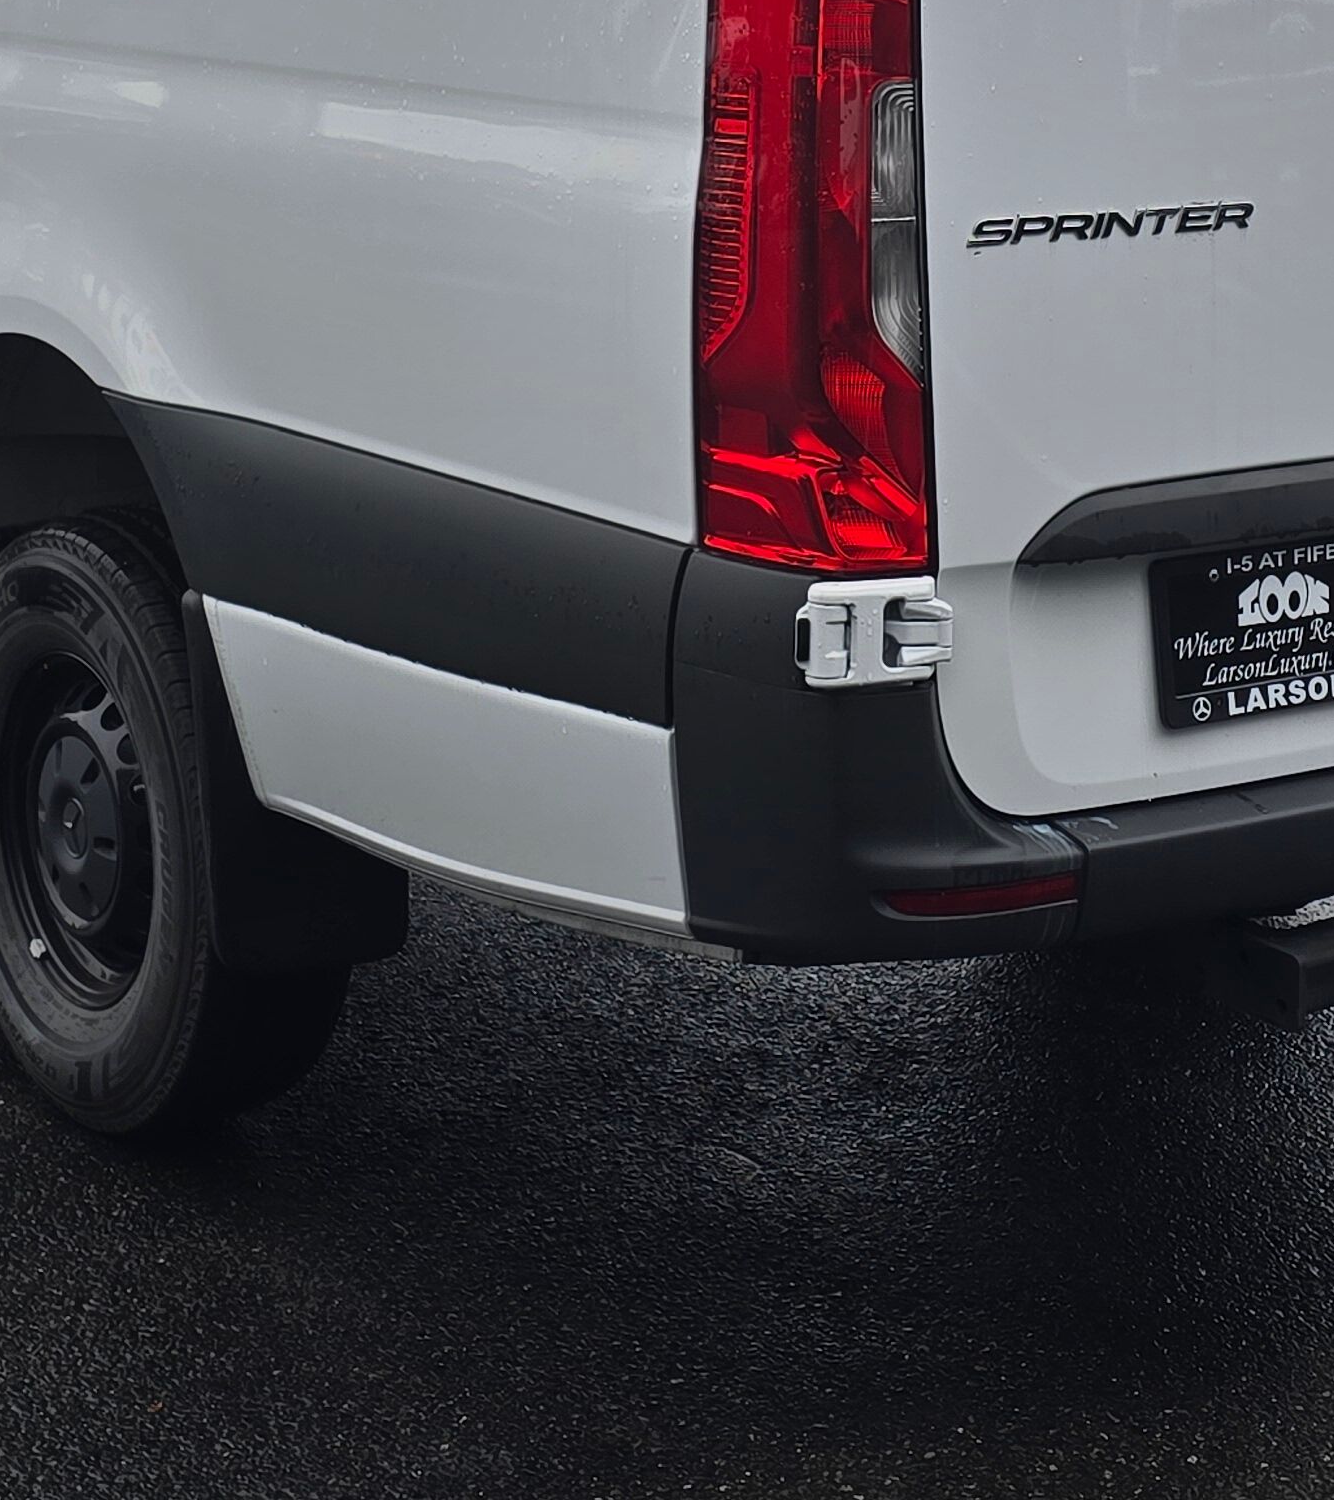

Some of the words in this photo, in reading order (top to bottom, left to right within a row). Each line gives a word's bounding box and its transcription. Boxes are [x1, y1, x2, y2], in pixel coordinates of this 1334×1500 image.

[966, 200, 1255, 248] SPRINTER
[1226, 555, 1253, 575] I-5
[1259, 550, 1287, 571] AT
[1237, 571, 1330, 627] LOOK
[1174, 632, 1235, 660] Where
[1240, 627, 1305, 652] Luxury
